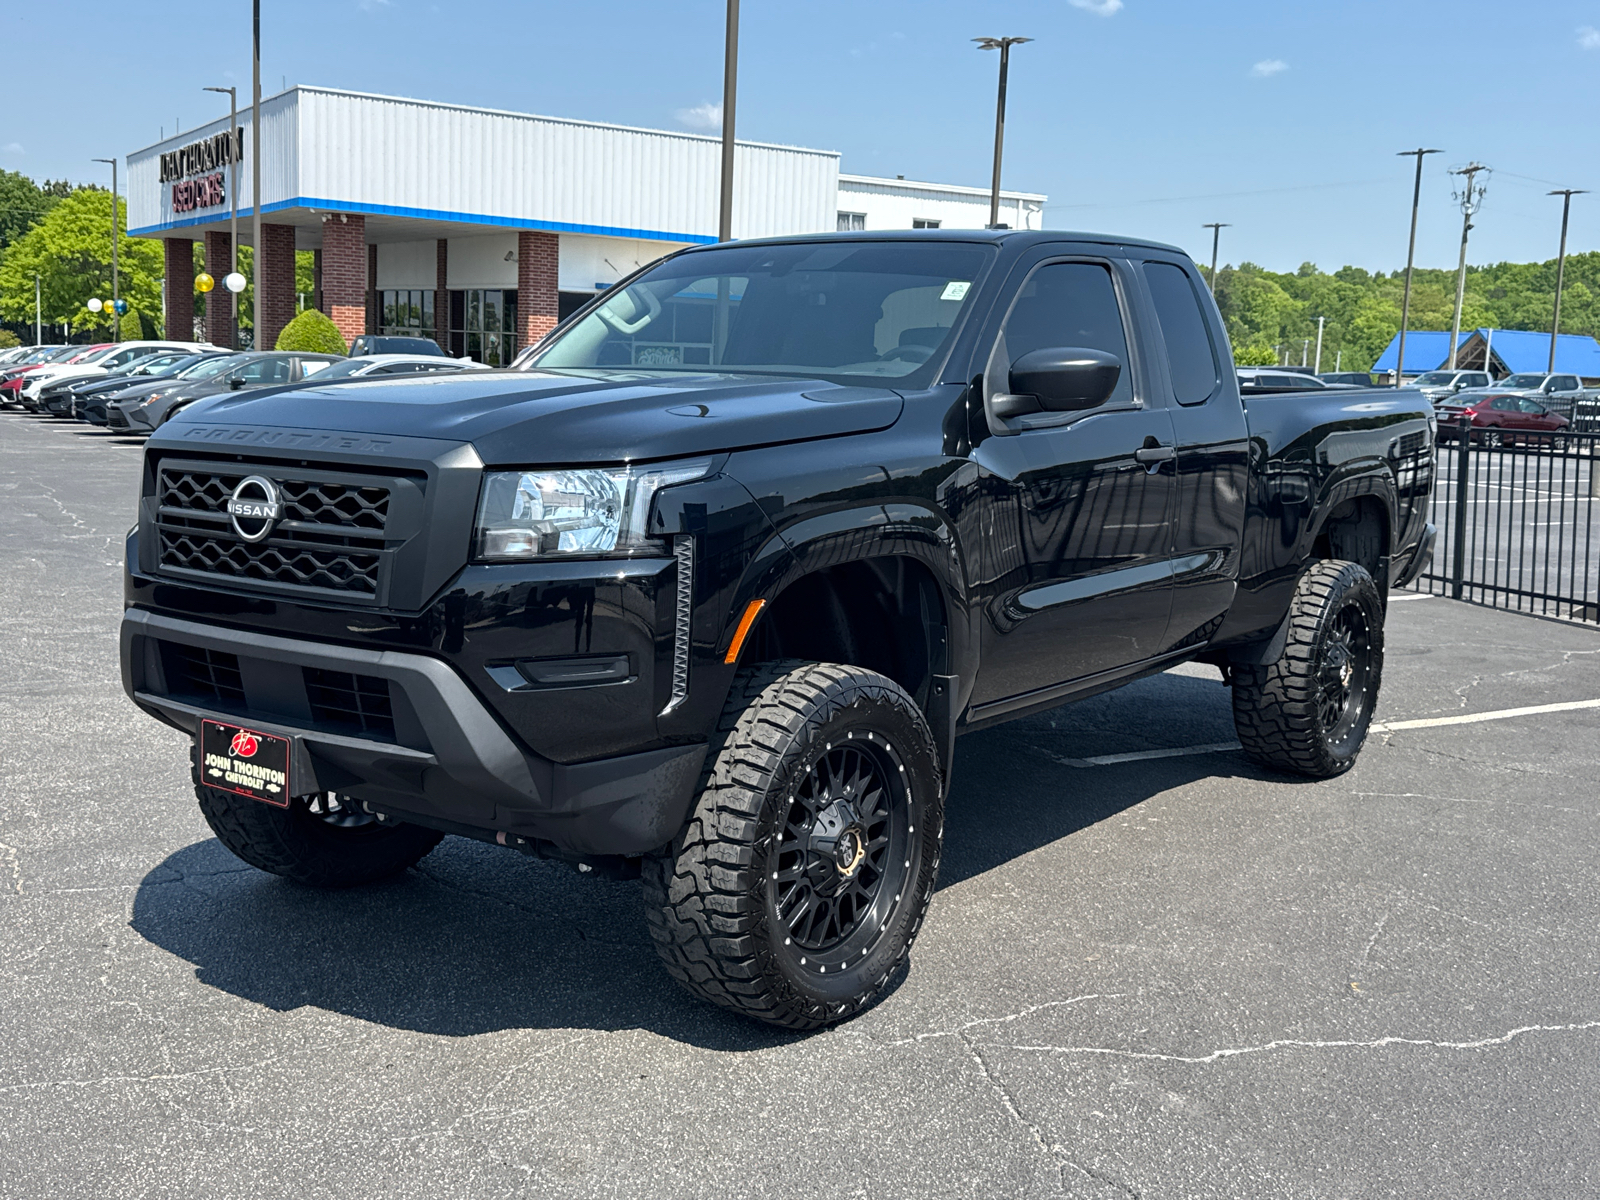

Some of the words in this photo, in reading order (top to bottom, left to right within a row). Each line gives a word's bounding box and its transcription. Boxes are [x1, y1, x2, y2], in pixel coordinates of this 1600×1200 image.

[159, 149, 185, 183] JOHN
[184, 127, 244, 175] THORNTON
[172, 179, 197, 213] USED
[196, 172, 225, 208] CARS
[183, 428, 392, 452] FRONTIER
[228, 503, 276, 517] NISSAN
[205, 753, 231, 771] JOHN
[233, 760, 285, 785] THORNTON
[225, 771, 265, 790] CHEVROLET
